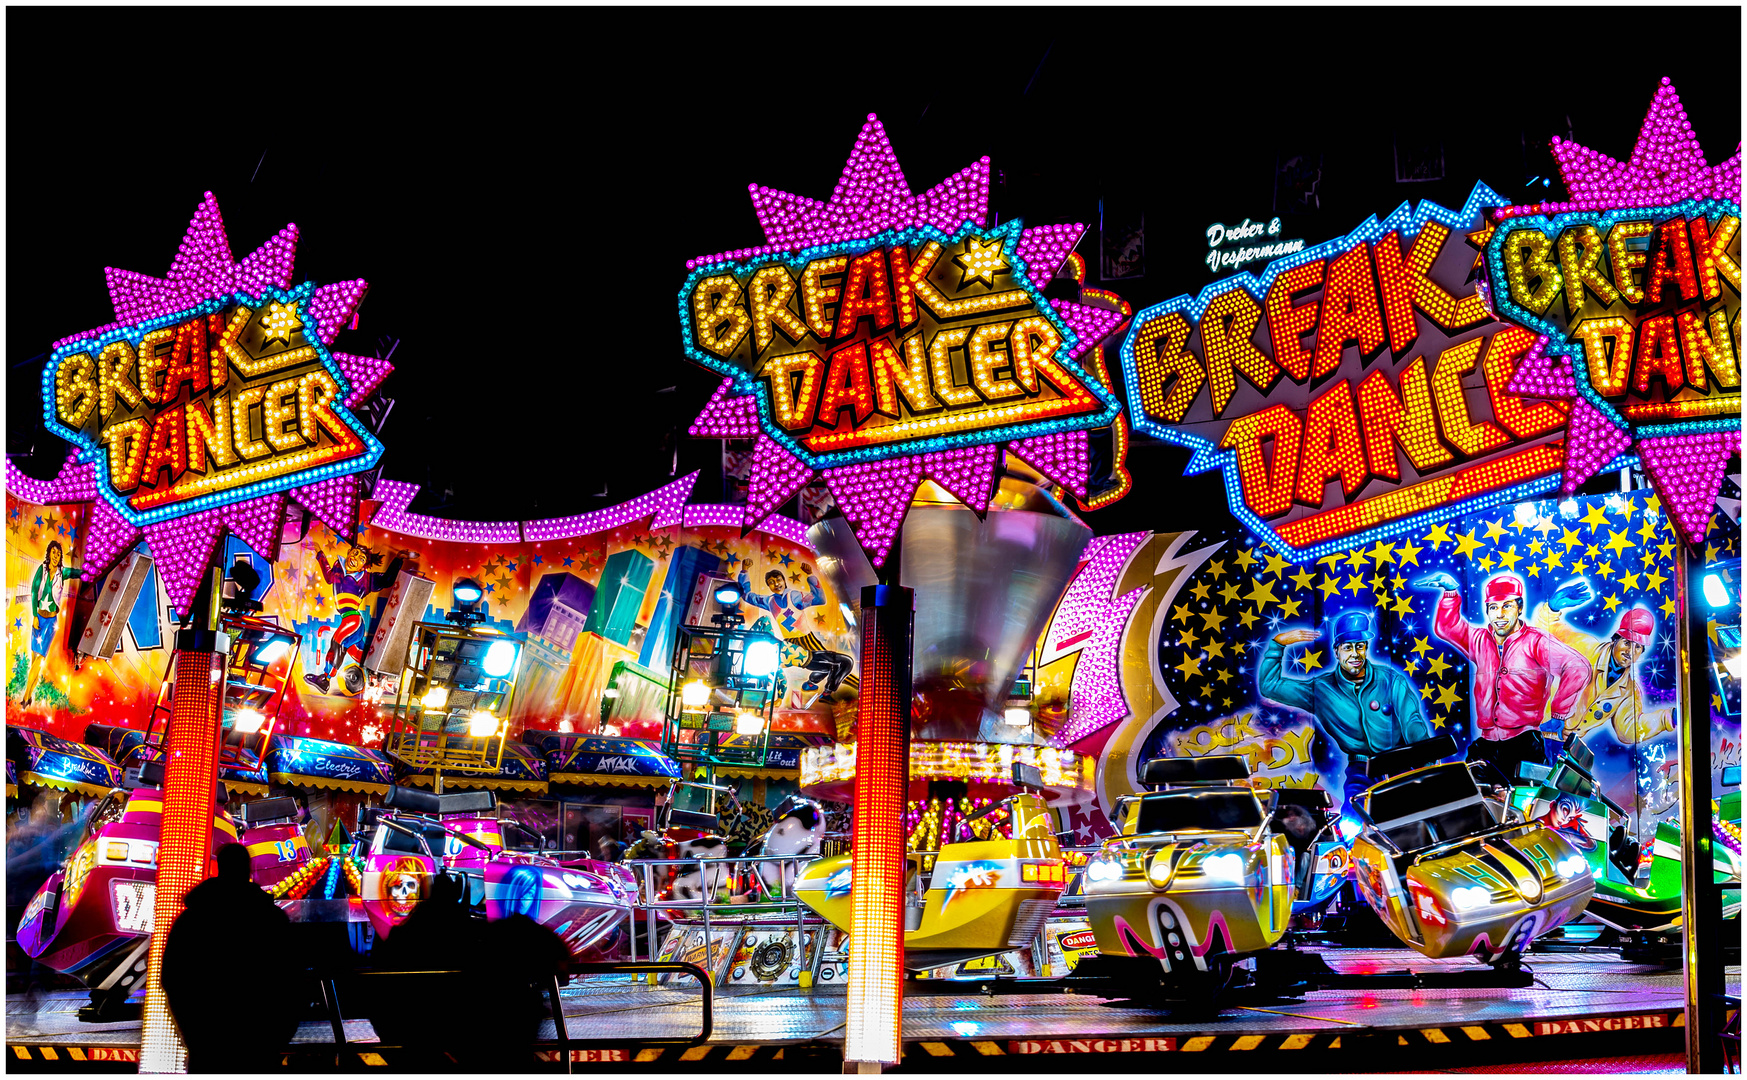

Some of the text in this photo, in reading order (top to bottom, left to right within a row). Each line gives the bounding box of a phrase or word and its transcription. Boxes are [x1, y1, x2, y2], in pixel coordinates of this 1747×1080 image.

[1207, 217, 1281, 247] Dreher &
[1206, 239, 1304, 272] Vespermann
[694, 240, 1032, 359] BREAK
[1133, 219, 1490, 423] BREAK
[55, 305, 319, 427] BREAK
[1571, 305, 1741, 397] DAN
[761, 316, 1092, 430] DANCER
[101, 369, 362, 491] DANCER
[315, 757, 361, 775] Electric
[594, 756, 642, 774] ATTACK
[274, 839, 297, 862] 13
[1541, 1015, 1663, 1035] DANGER
[93, 1049, 141, 1062] DAN
[1018, 1038, 1170, 1054] DANGER
